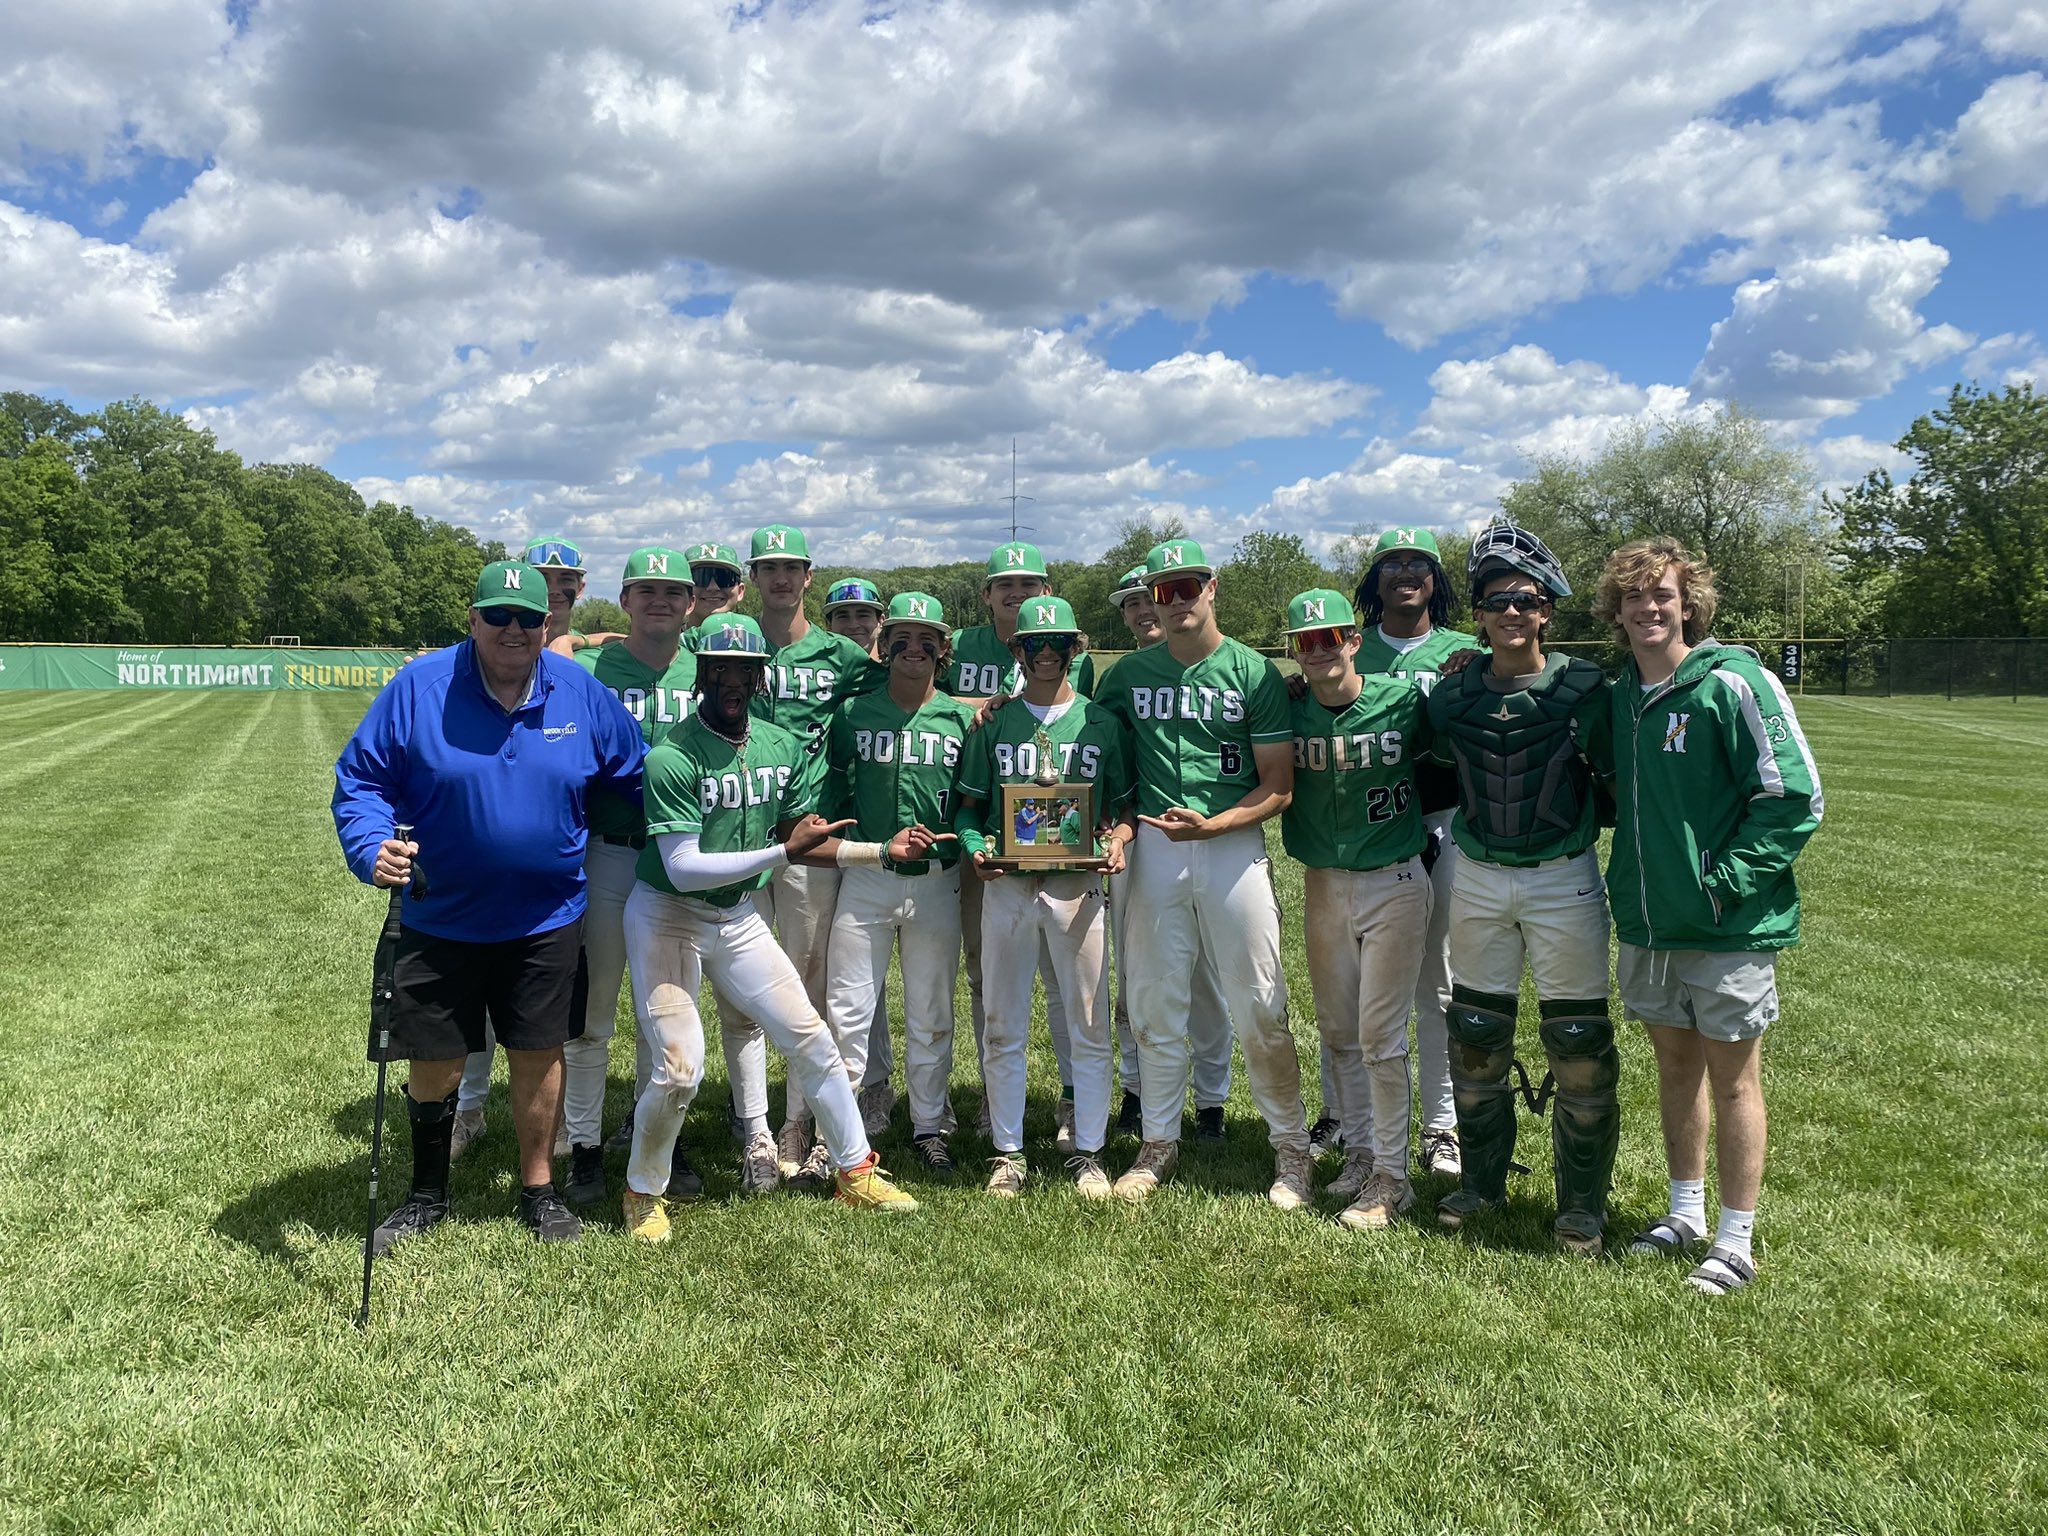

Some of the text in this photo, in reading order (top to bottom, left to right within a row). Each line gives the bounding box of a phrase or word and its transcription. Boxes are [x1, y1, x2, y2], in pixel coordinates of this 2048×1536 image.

[765, 530, 787, 550] N
[1395, 529, 1417, 545] N
[647, 553, 669, 574] N
[699, 544, 719, 560] N
[1005, 548, 1025, 567] N
[1162, 545, 1184, 568] N
[503, 569, 522, 590] N
[908, 598, 929, 618] N
[1035, 604, 1057, 626] N
[1303, 597, 1326, 623] N
[117, 651, 163, 664] Home of
[1785, 645, 1798, 678] 343
[117, 664, 274, 685] NORTHMONT
[607, 687, 704, 723] OLT
[1131, 685, 1245, 722] BOLTS
[805, 721, 827, 755] 3
[1662, 712, 1691, 753] N
[1767, 715, 1788, 743] 3
[855, 729, 963, 768] BOLTS
[1219, 742, 1243, 776] 6
[1293, 730, 1403, 771] BOLTS
[700, 765, 793, 815] BOLTS
[936, 788, 949, 825] 1
